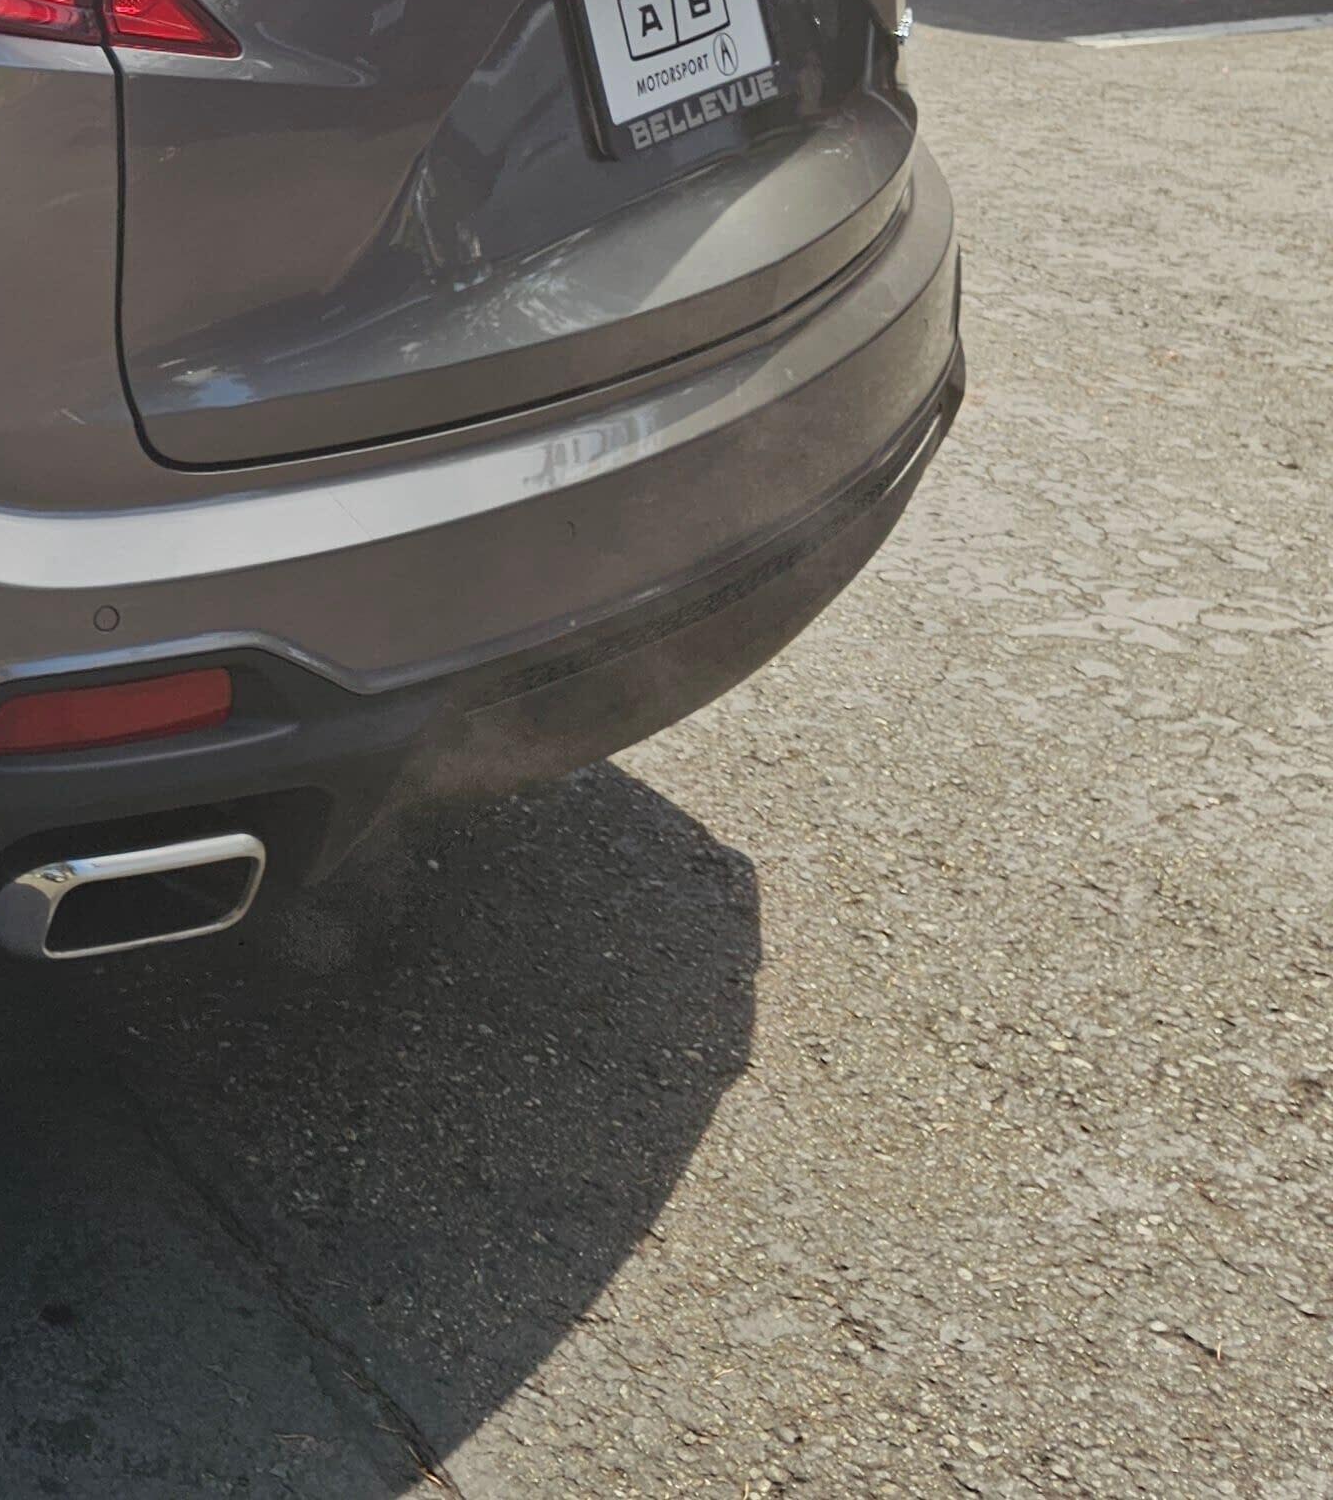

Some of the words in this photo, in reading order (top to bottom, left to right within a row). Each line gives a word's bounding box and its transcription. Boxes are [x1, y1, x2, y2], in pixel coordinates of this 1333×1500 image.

[637, 3, 664, 38] A
[636, 52, 710, 97] MOTORSPORT
[628, 69, 779, 151] BELLEVUE
